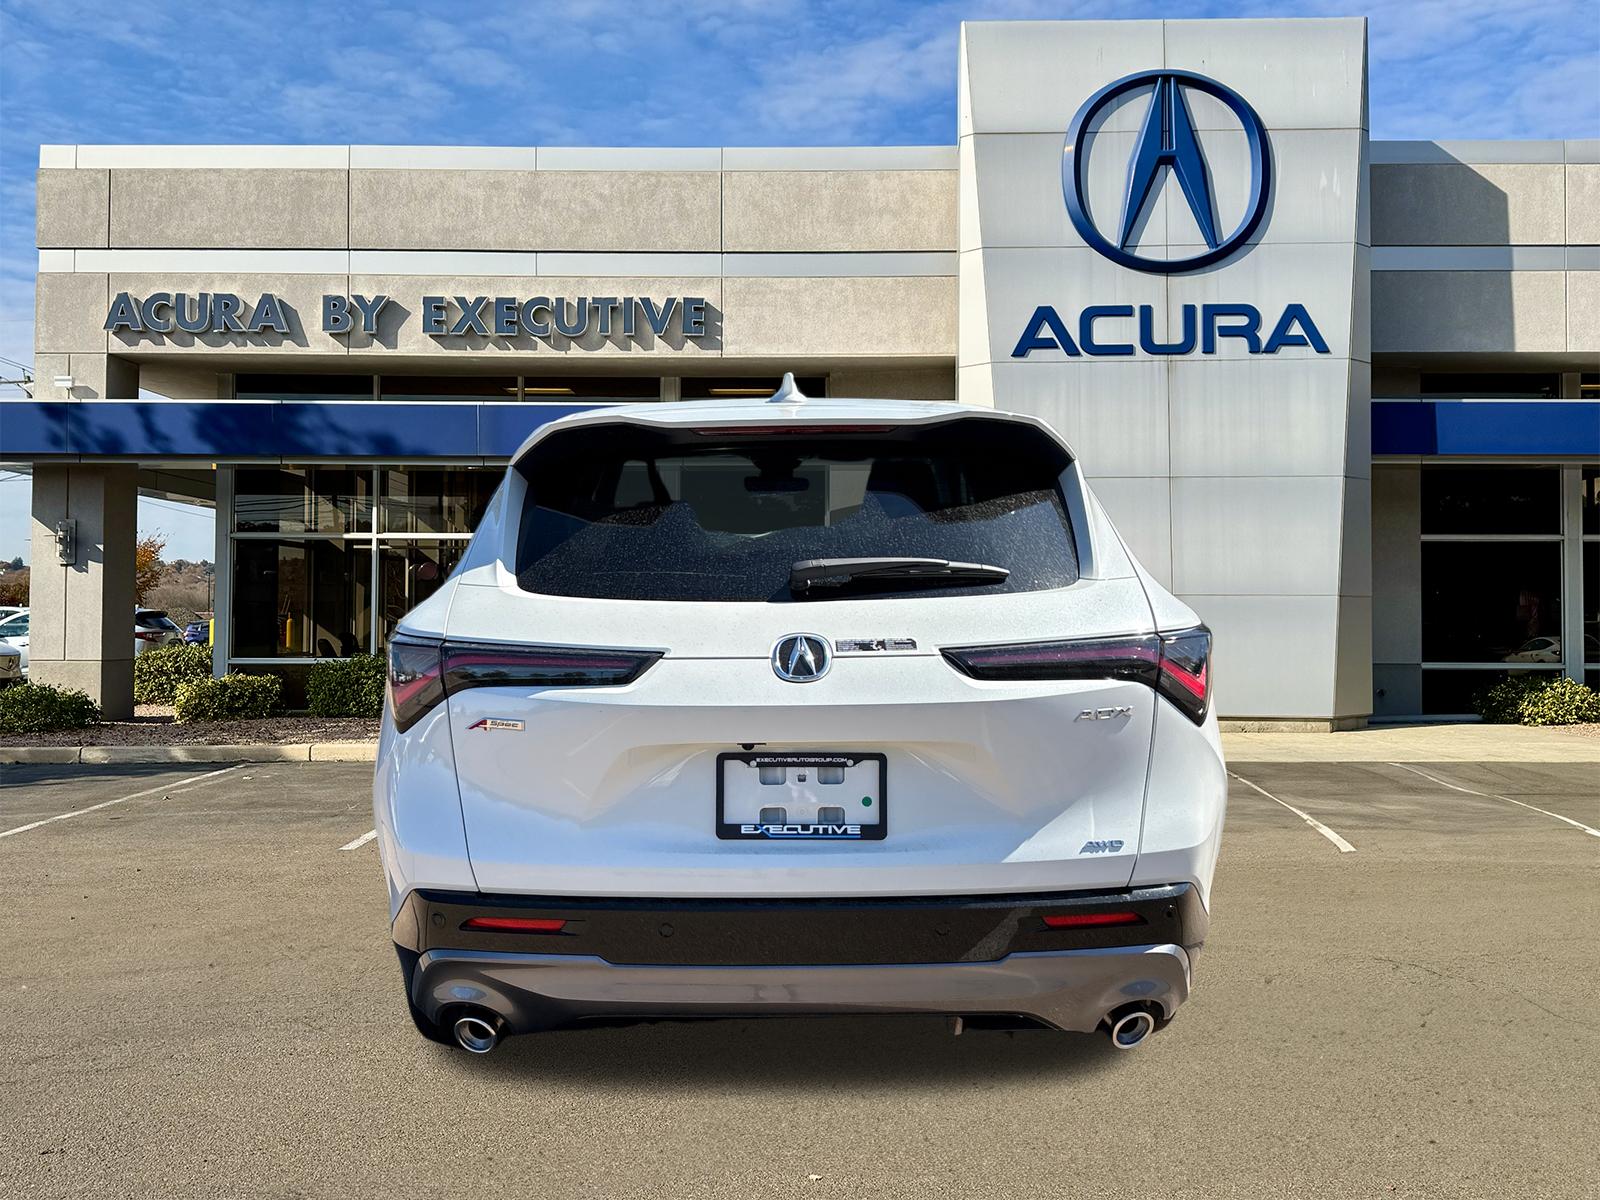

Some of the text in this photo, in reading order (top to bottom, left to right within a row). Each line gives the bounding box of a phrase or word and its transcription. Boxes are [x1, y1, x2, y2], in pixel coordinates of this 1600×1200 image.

[104, 292, 708, 337] ACURA BY EXECUTIVE
[1011, 303, 1332, 357] ACURA
[740, 824, 862, 836] EXECUTIVE
[1079, 839, 1125, 854] AWD
